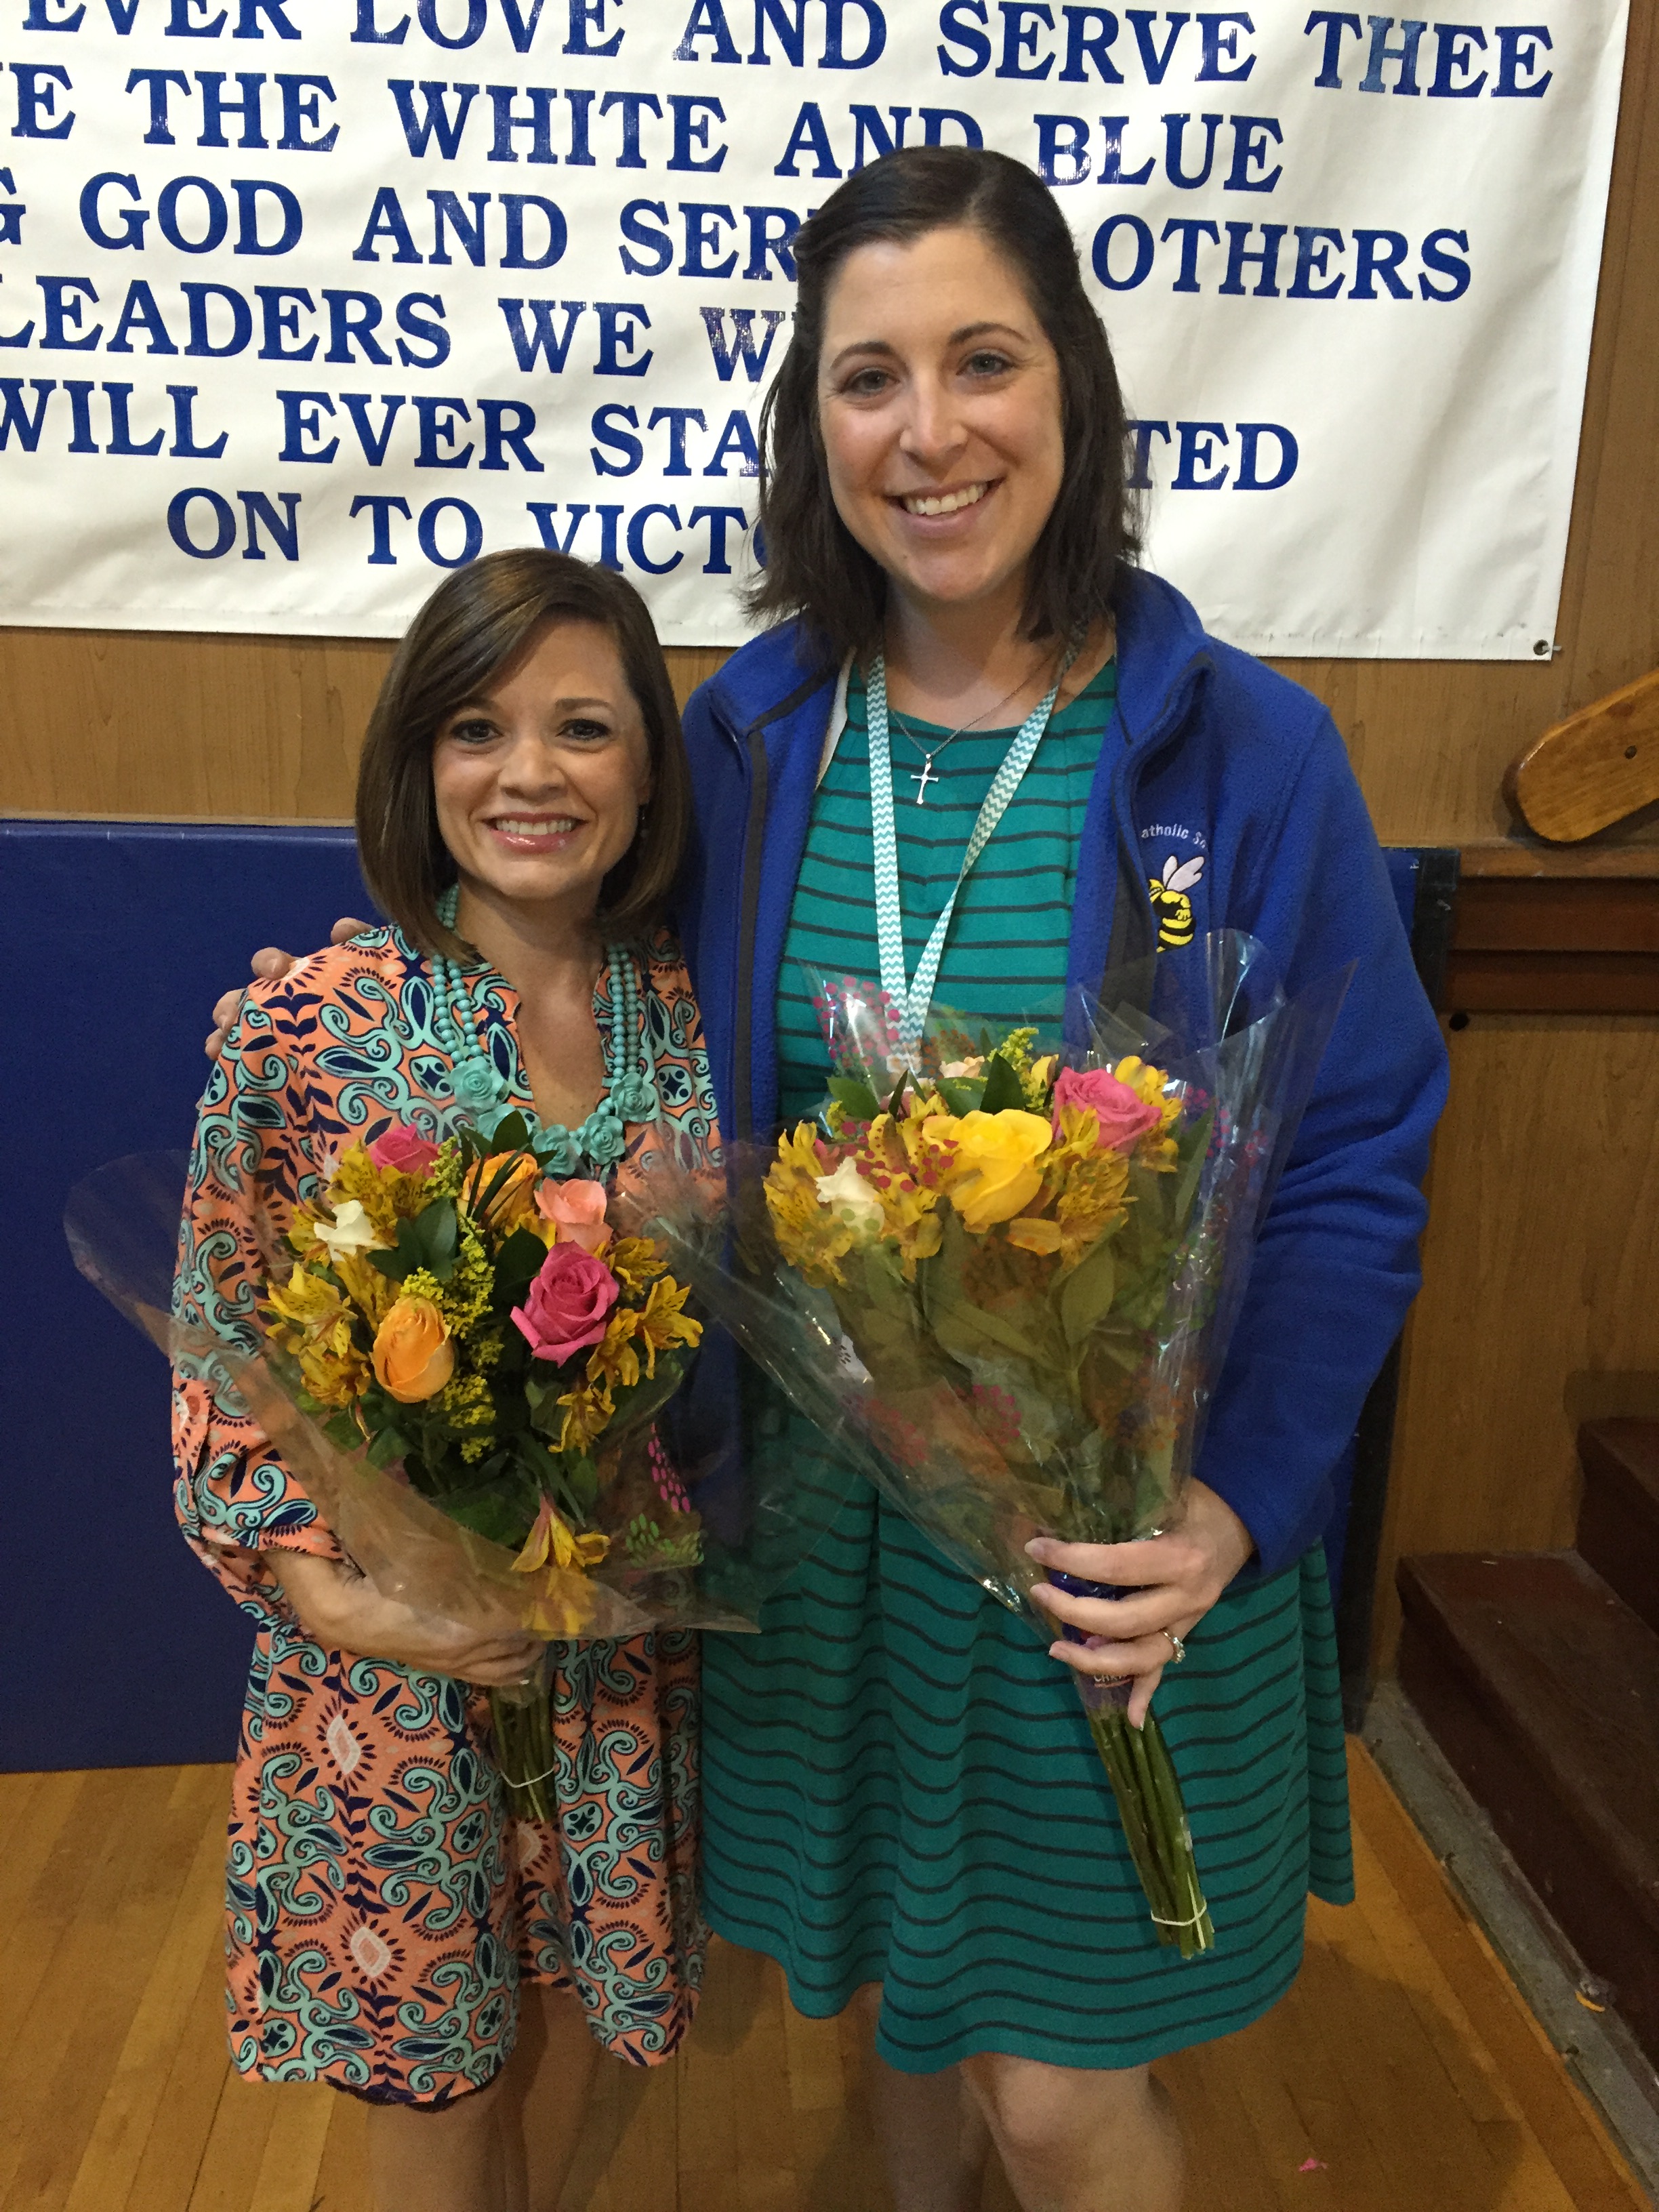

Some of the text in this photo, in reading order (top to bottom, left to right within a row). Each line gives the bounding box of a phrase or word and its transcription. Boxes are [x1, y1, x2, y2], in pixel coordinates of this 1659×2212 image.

[350, 0, 626, 58] LOVE
[672, 0, 888, 70] AND
[937, 0, 1257, 85] SERVE
[1305, 12, 1554, 99] THEE
[125, 68, 341, 153] THE
[388, 79, 729, 173] WHITE
[1033, 114, 1284, 194] BLUE
[79, 172, 304, 257] GOD
[352, 187, 569, 270] AND
[619, 199, 819, 283] SER
[1092, 214, 1471, 303] OTHERS
[498, 298, 654, 377] WE
[0, 377, 229, 459] WILL
[276, 390, 545, 473] EVER
[167, 488, 769, 575] ON TO VICT
